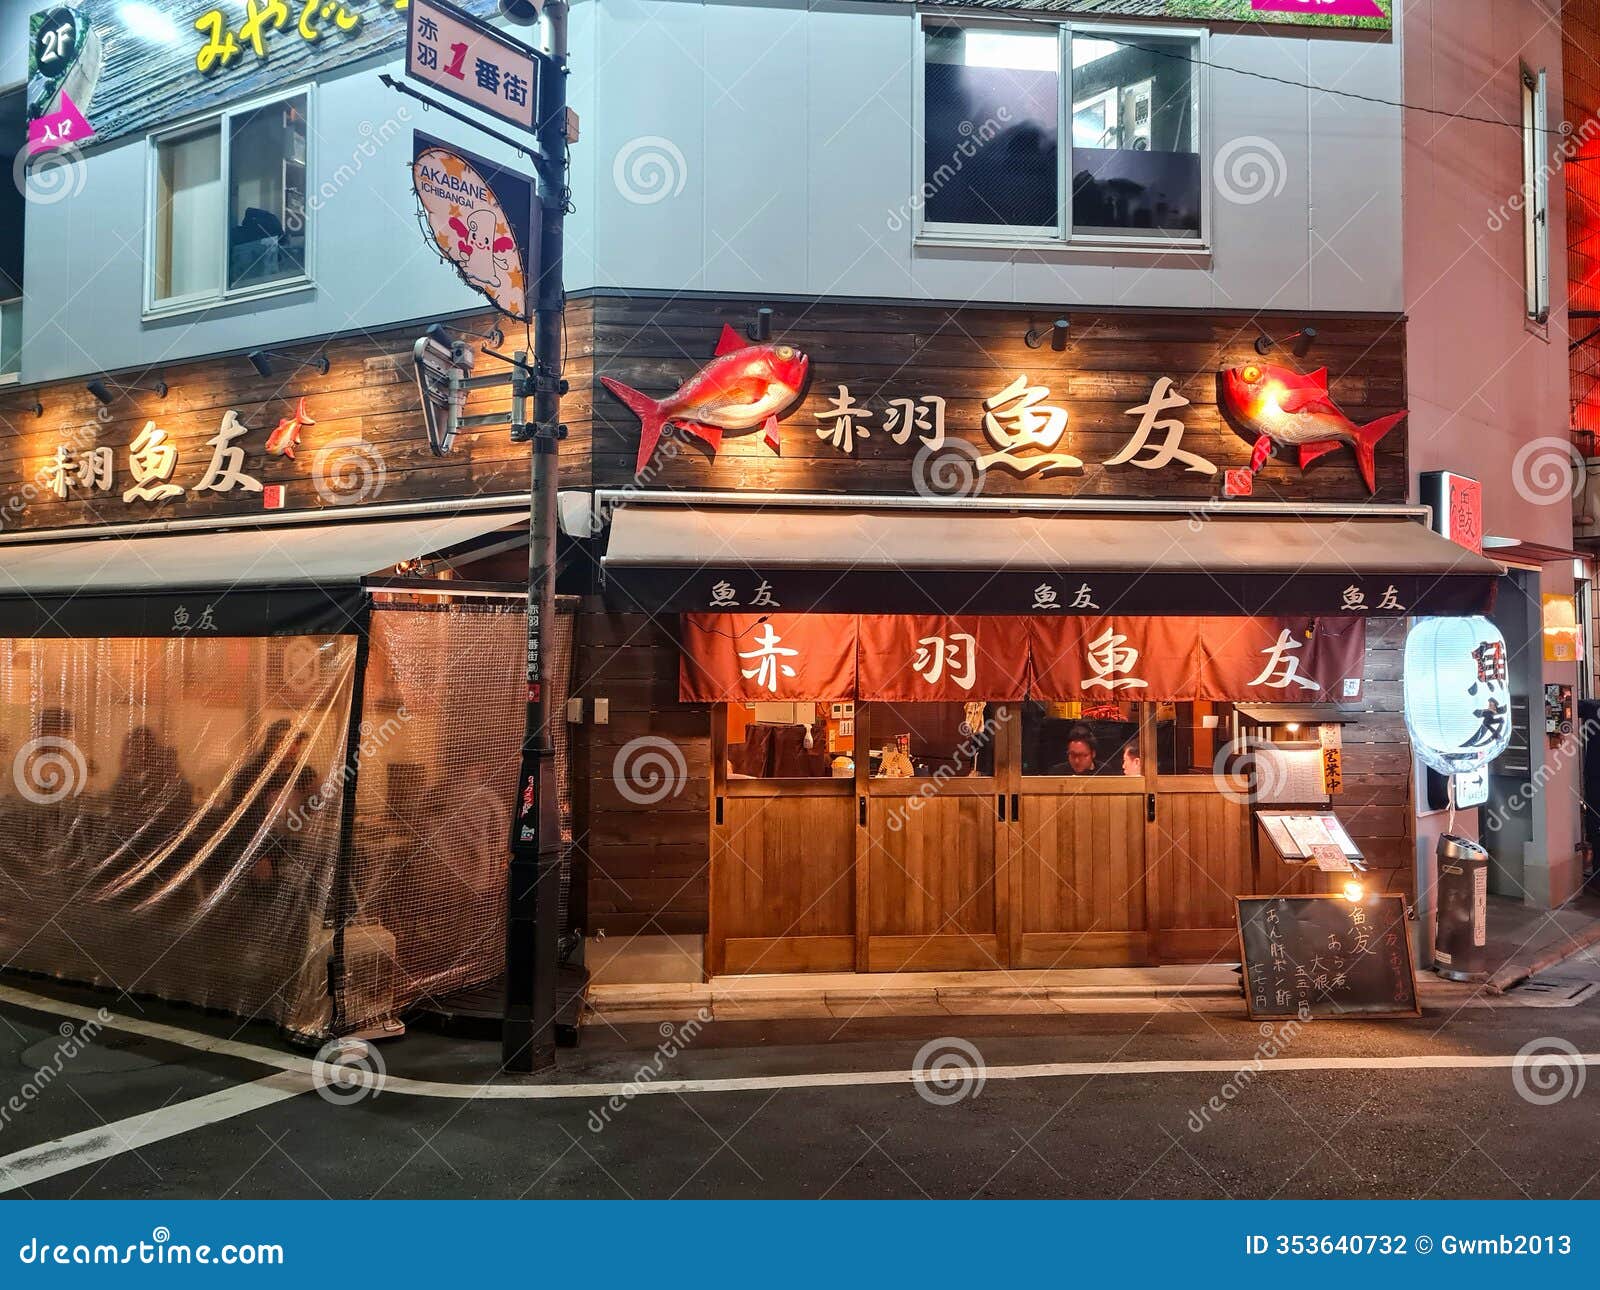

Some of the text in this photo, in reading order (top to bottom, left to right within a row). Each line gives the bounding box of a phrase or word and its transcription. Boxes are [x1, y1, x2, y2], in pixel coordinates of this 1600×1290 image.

[41, 23, 71, 62] 2F
[417, 16, 528, 107] 赤羽1番街
[41, 120, 71, 144] 入口
[420, 167, 488, 201] AKABANE
[421, 181, 474, 209] ICHIBANGAI
[709, 580, 780, 607] 魚友
[1032, 583, 1100, 609] 魚友
[1340, 584, 1406, 610] 魚友
[171, 605, 219, 632] 魚友
[1325, 748, 1341, 793] 営業中
[1348, 906, 1376, 955] 魚友
